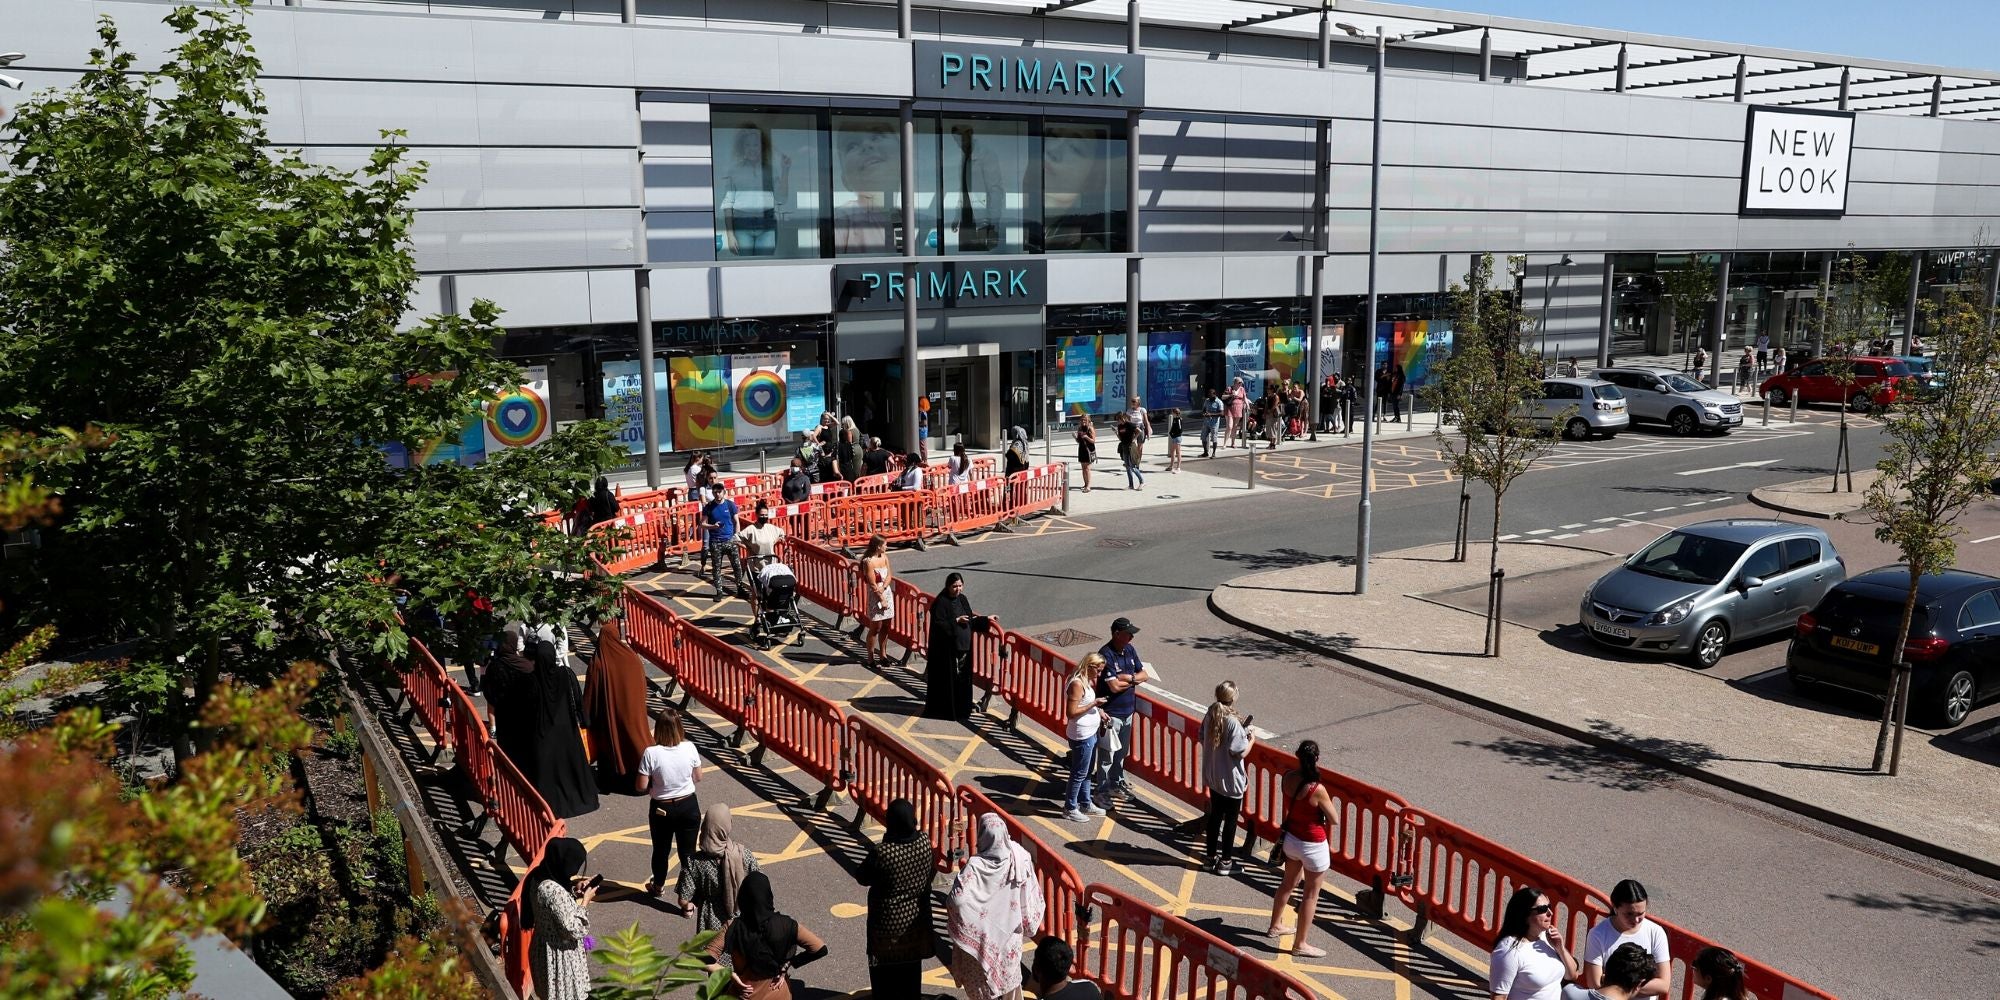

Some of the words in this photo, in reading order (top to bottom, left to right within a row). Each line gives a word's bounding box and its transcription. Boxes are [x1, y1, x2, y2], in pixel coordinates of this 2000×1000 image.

[941, 51, 1126, 97] PRIMARK
[1769, 128, 1835, 157] NEW
[1759, 166, 1837, 194] LOOK
[1091, 306, 1163, 321] PRIMRK
[662, 322, 760, 341] PRIMARK
[1157, 344, 1183, 369] SO
[1112, 361, 1126, 373] CA
[1115, 374, 1126, 385] ST
[1157, 370, 1183, 383] GOOD
[1112, 385, 1126, 399] SA
[620, 427, 646, 443] LOV
